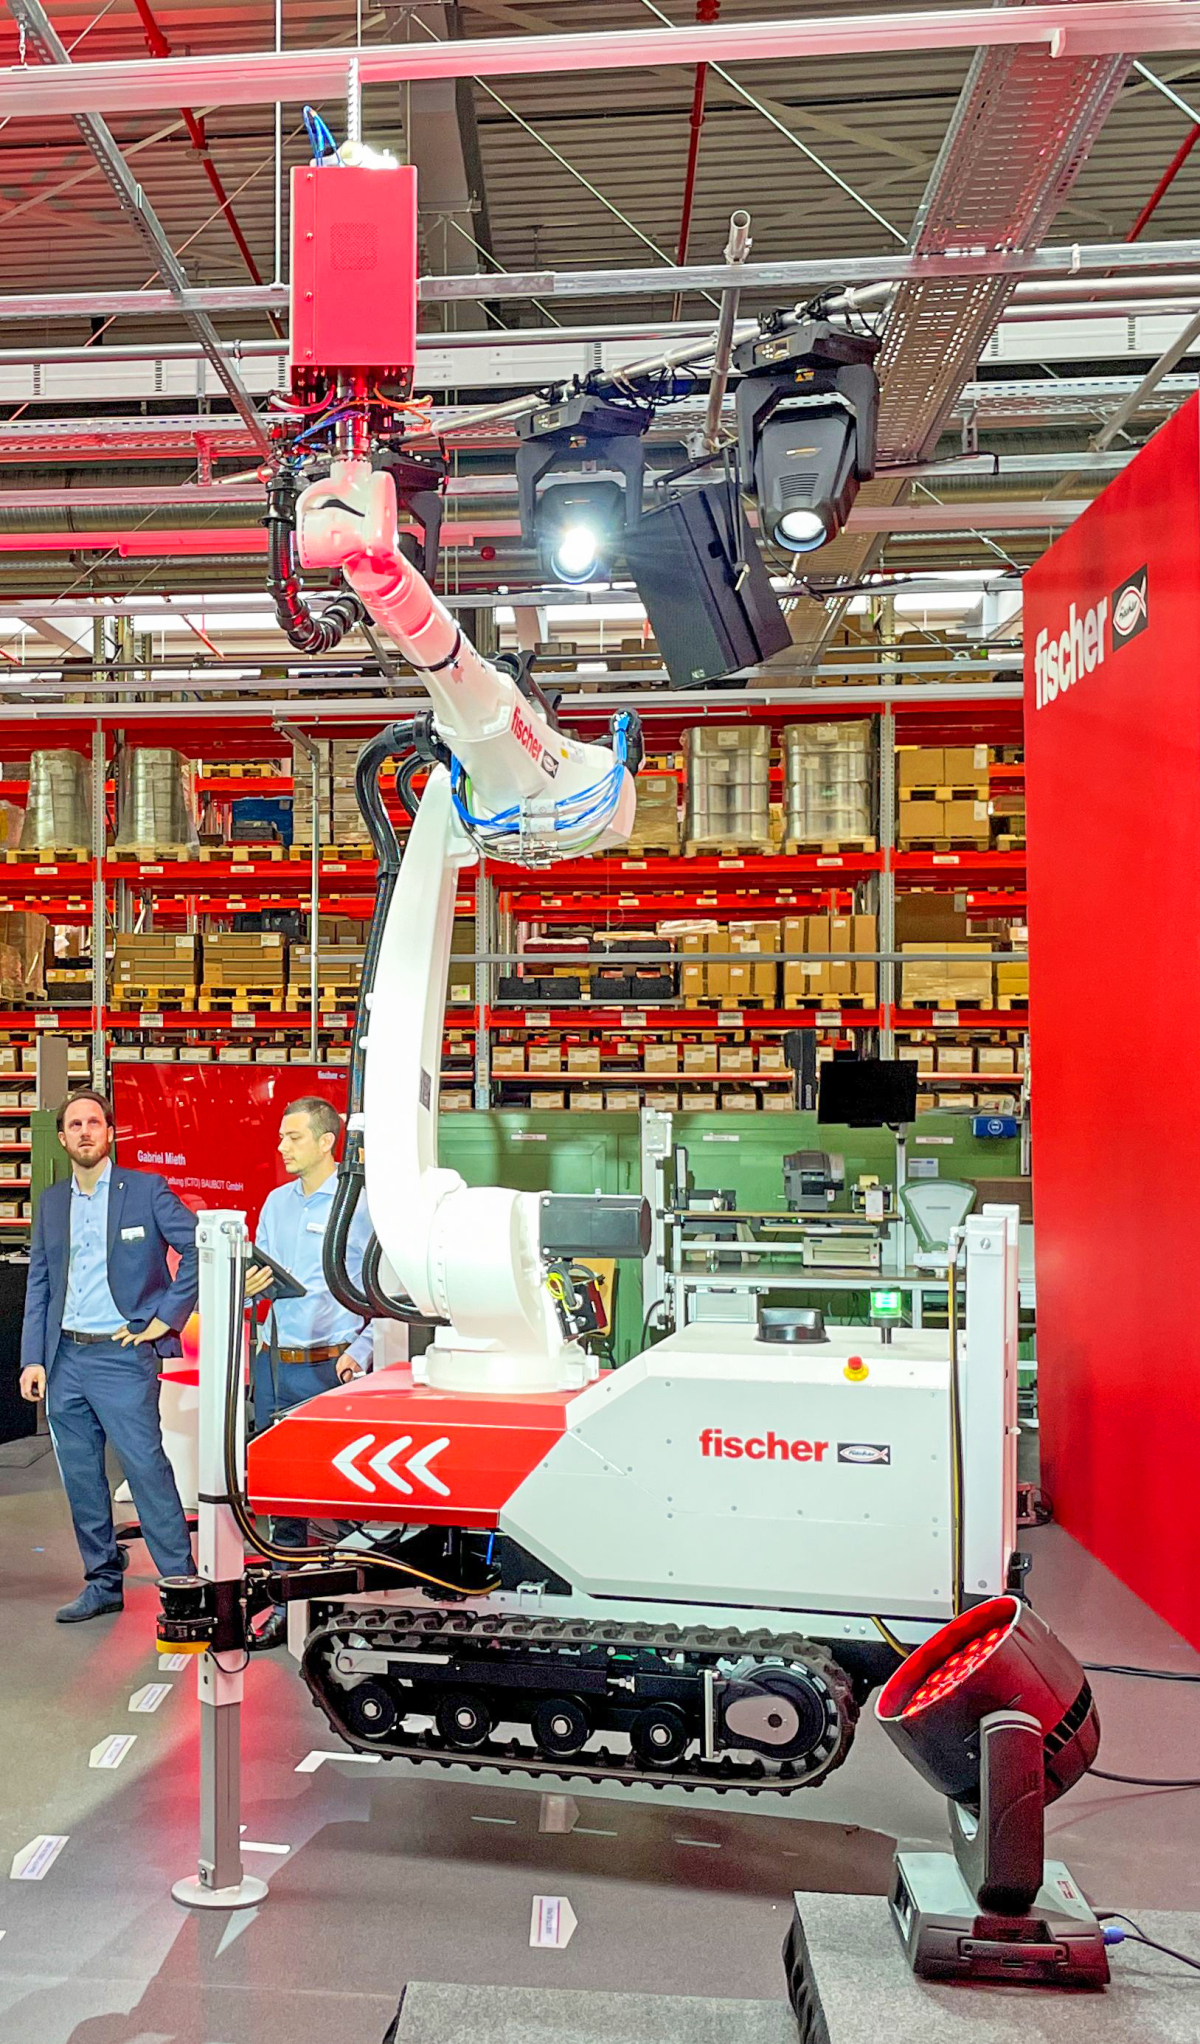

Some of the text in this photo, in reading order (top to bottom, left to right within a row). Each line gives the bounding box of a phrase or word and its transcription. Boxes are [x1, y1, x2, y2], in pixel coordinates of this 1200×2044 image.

[1034, 596, 1108, 710] fischer
[511, 706, 543, 762] fischer
[137, 1149, 186, 1166] Gabriel Mieth
[226, 1181, 244, 1192] GmbH
[699, 1428, 829, 1462] fischer
